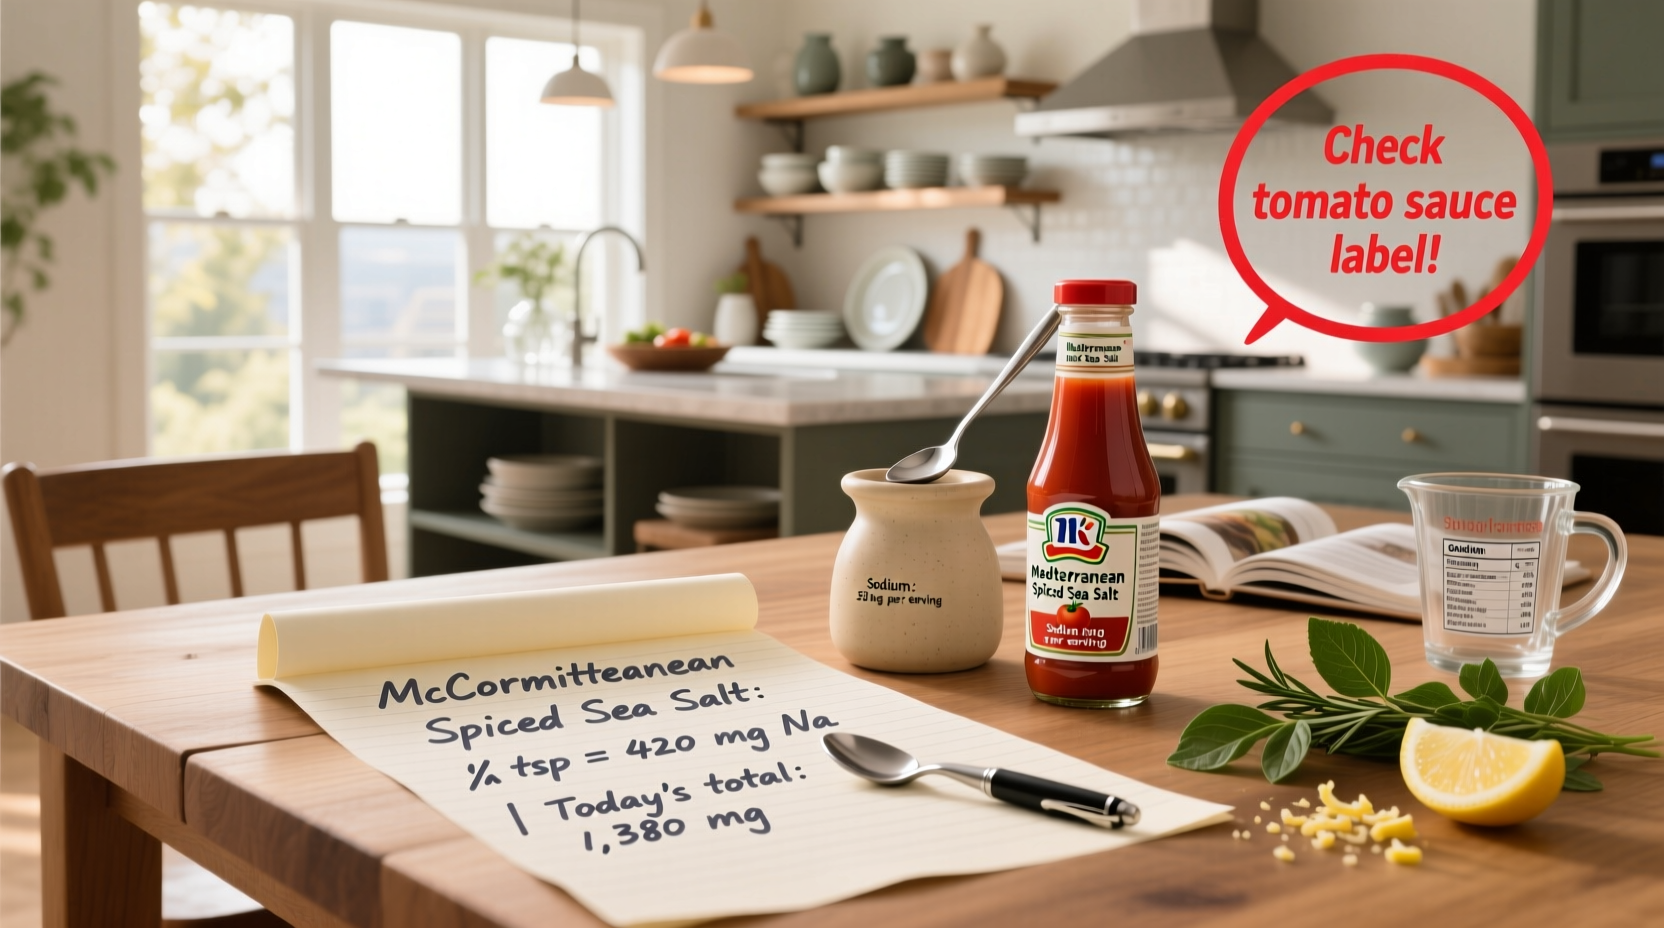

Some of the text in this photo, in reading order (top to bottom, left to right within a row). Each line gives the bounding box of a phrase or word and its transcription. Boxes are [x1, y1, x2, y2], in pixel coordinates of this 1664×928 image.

[867, 577, 916, 593] Sodium:
[1067, 586, 1089, 600] Sea
[1093, 586, 1119, 601] Salt
[378, 654, 735, 710] McCormitteanean
[425, 681, 765, 751] Spiced Sea Salt:
[510, 755, 571, 782] tsp
[585, 750, 610, 764] =
[625, 734, 696, 760] 420
[714, 727, 770, 752] mg
[781, 709, 840, 736] Na
[544, 782, 692, 820] Today's
[703, 761, 807, 794] total:
[583, 806, 771, 855] 1,380 mg
